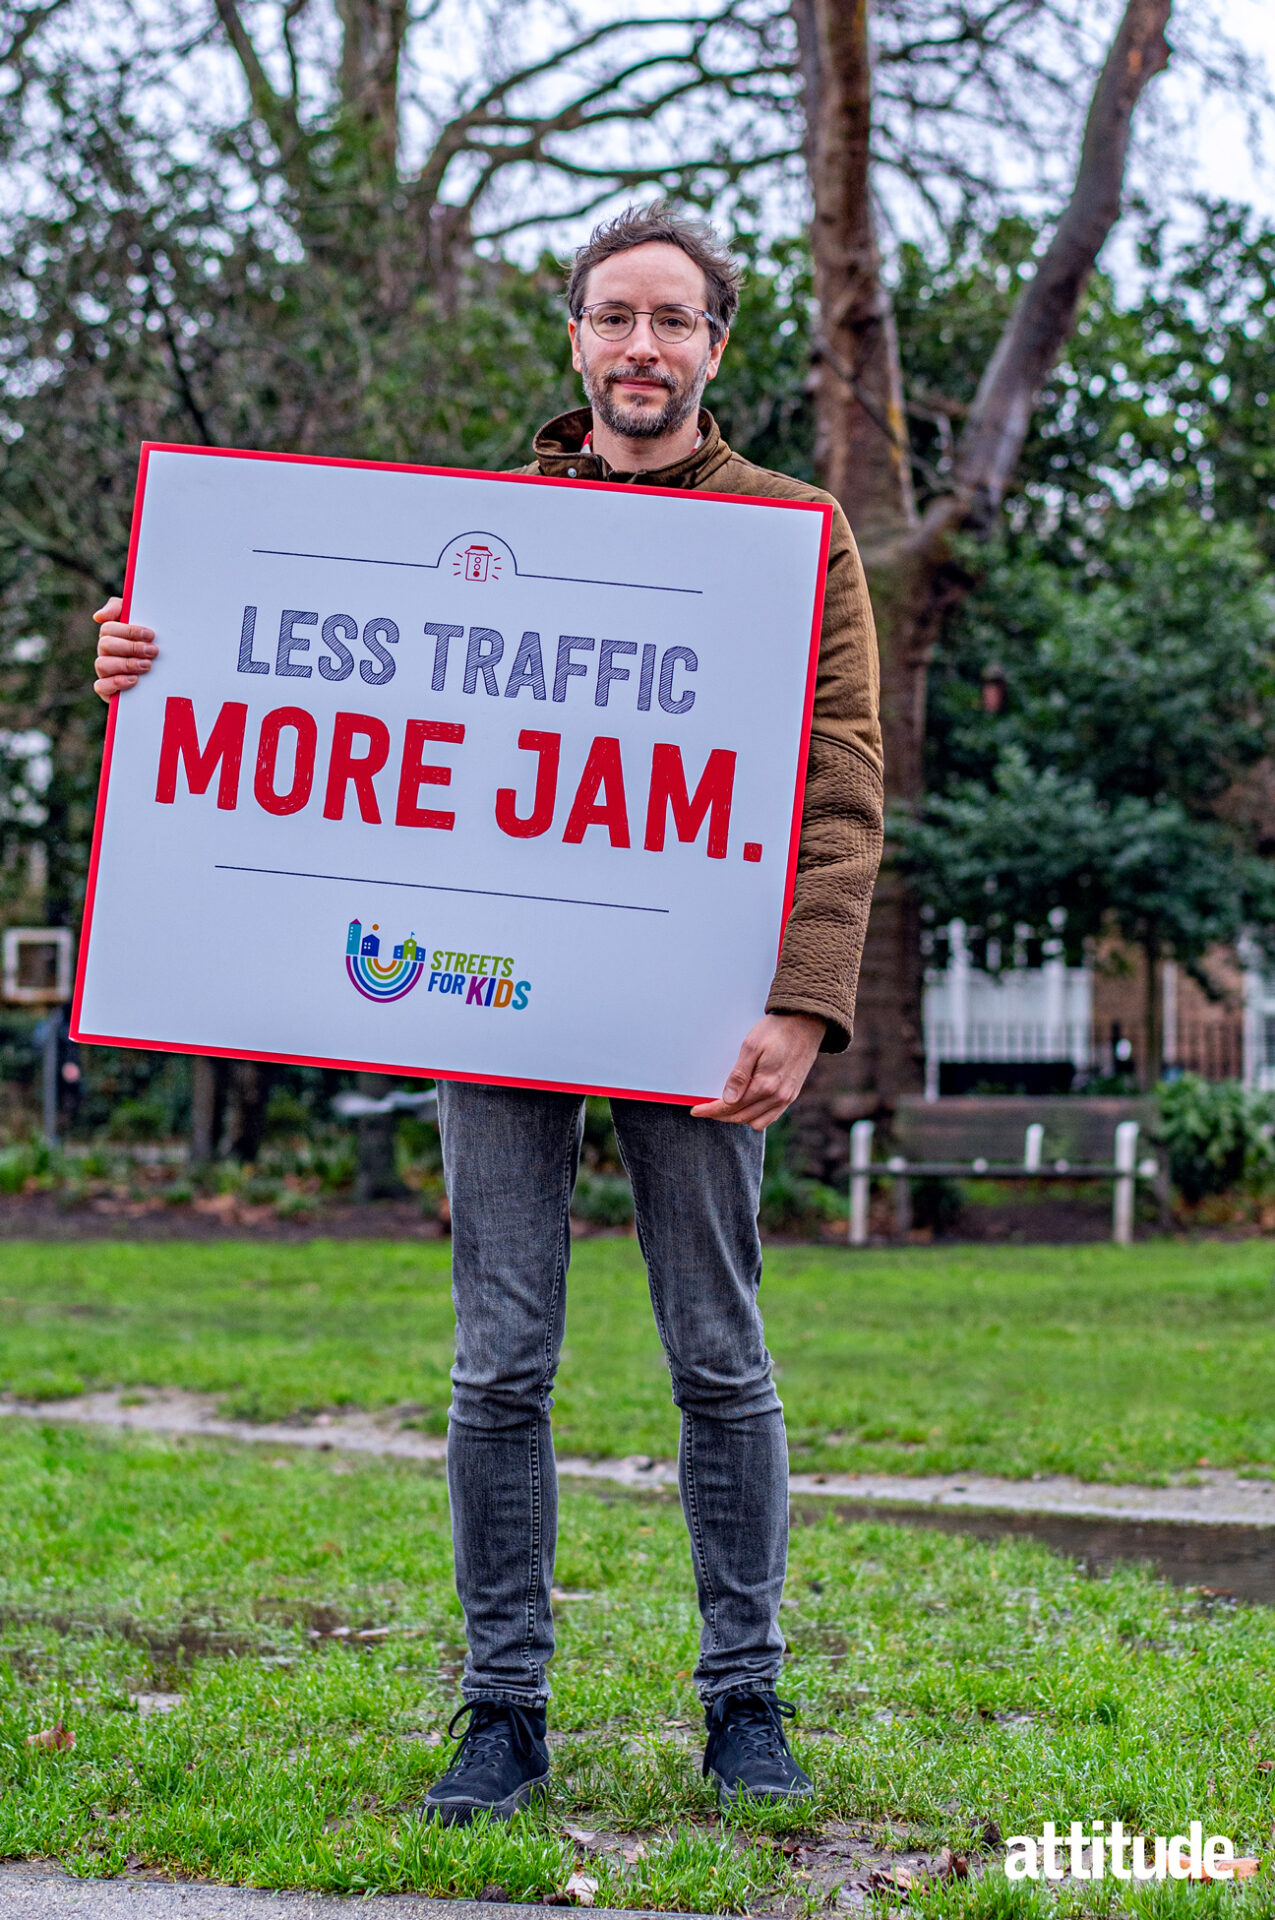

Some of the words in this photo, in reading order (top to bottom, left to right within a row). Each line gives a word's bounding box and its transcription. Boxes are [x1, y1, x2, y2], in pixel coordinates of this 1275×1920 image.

[237, 605, 400, 686] LESS
[424, 622, 699, 715] TRAFFIC
[154, 696, 466, 831] MORE
[495, 729, 763, 863] JAM.
[427, 972, 466, 995] FOR
[465, 975, 532, 1010] KIDS
[430, 950, 515, 978] STREETS
